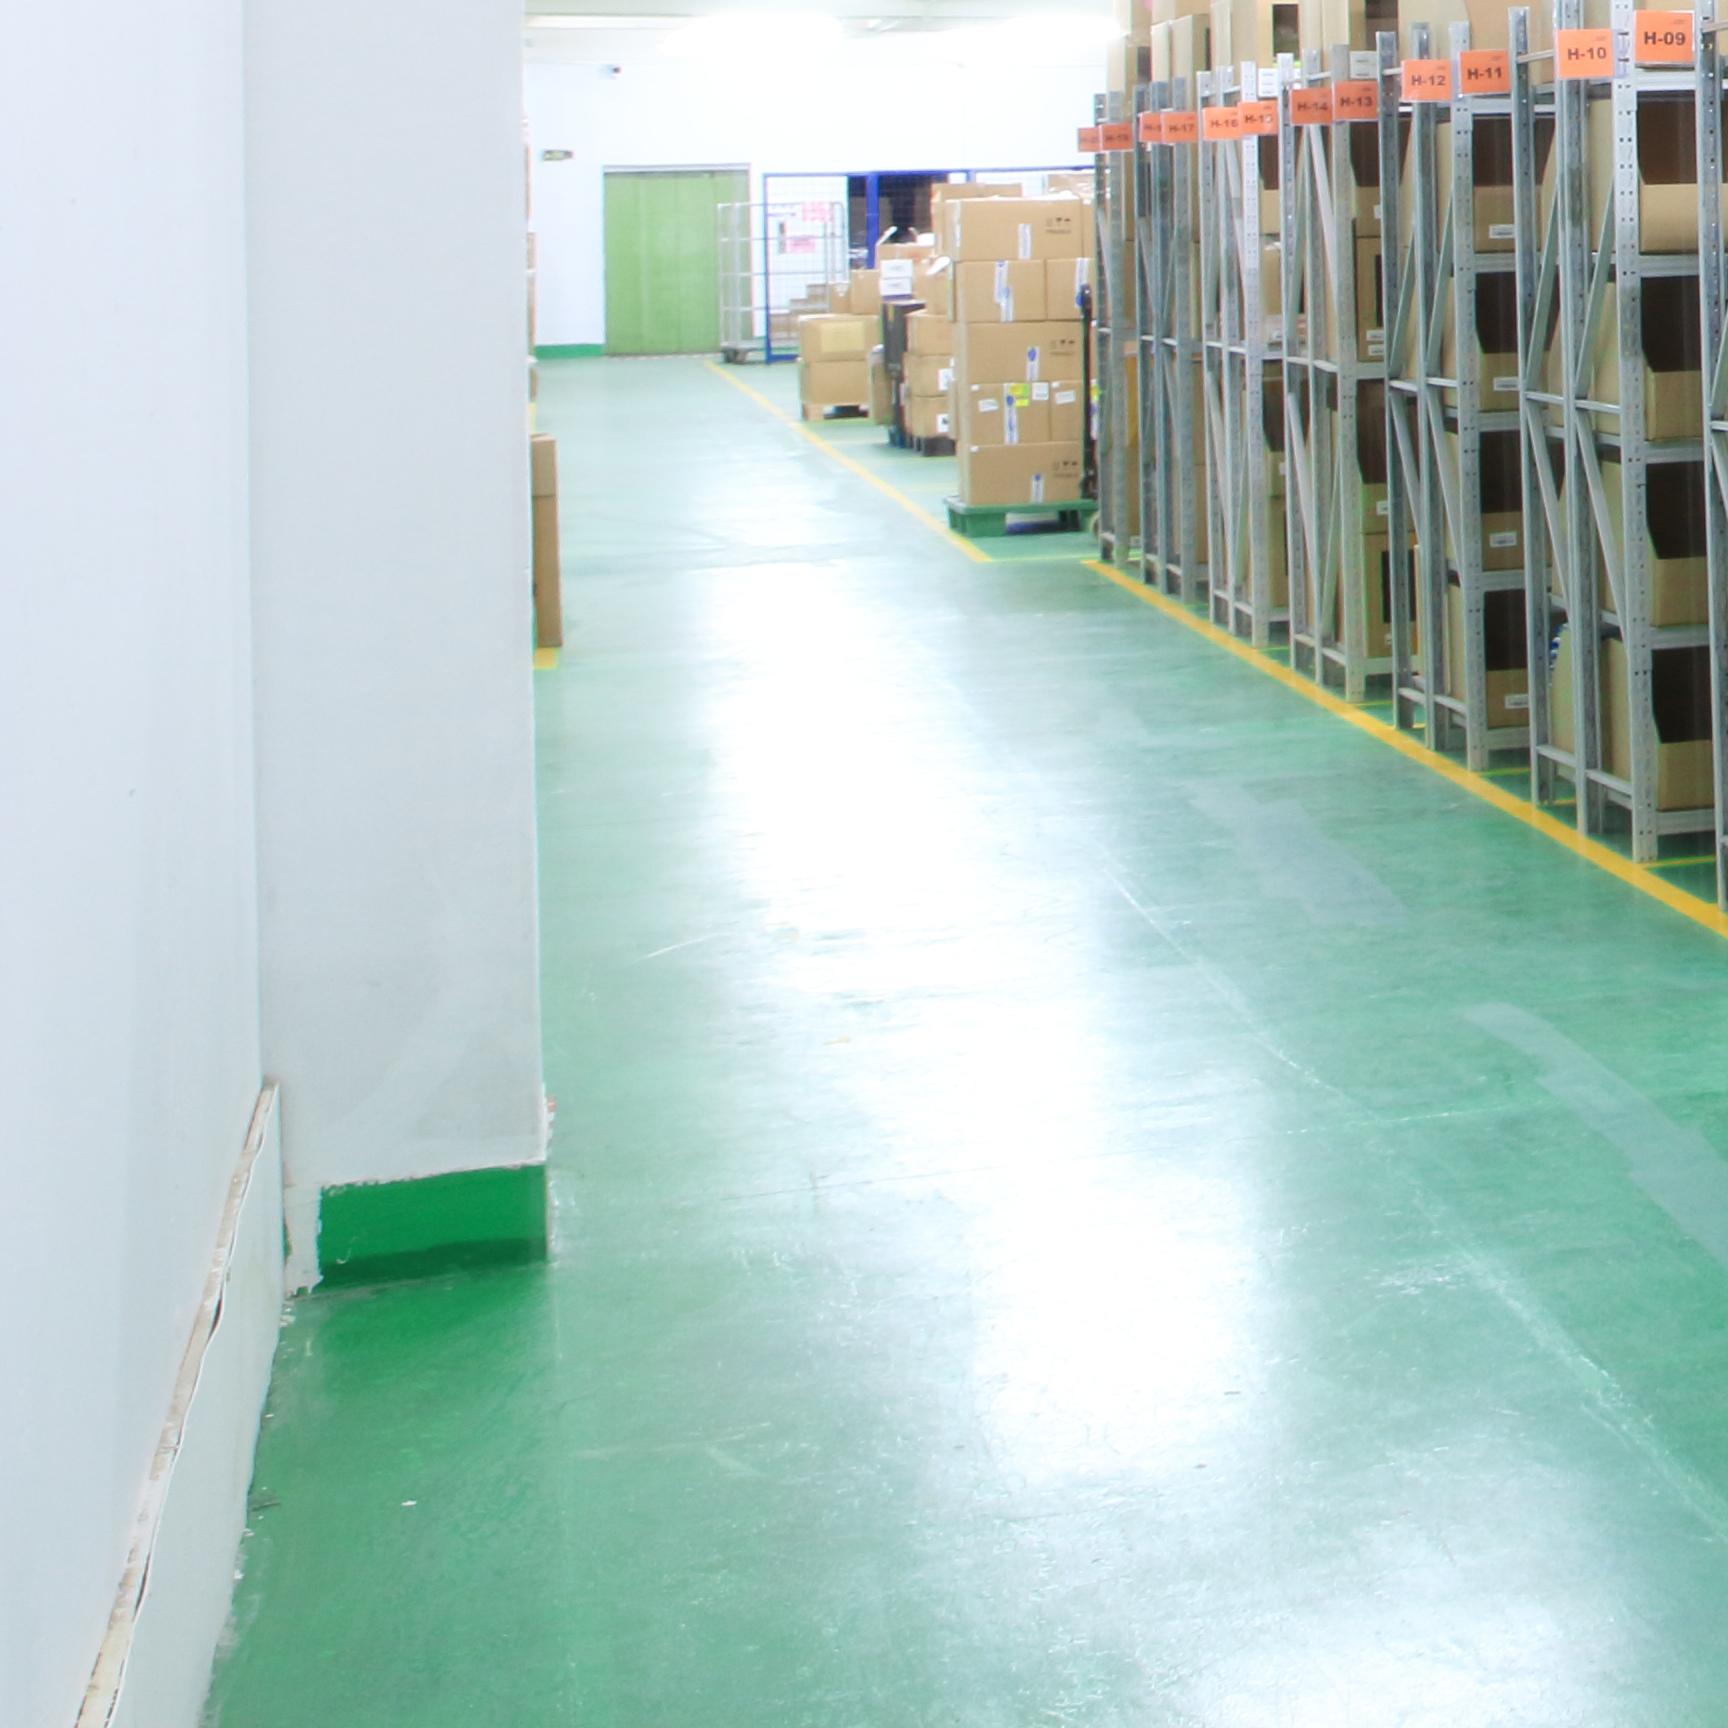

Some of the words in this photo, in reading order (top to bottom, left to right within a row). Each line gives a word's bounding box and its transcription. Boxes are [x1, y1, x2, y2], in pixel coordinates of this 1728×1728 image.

[1644, 31, 1686, 46] H-09
[1567, 47, 1607, 61] H-10
[1467, 67, 1502, 80] H-11
[1411, 75, 1446, 86] H-12
[1297, 102, 1329, 112] H-14
[1340, 97, 1373, 108] H-13
[1144, 123, 1162, 131] H-1
